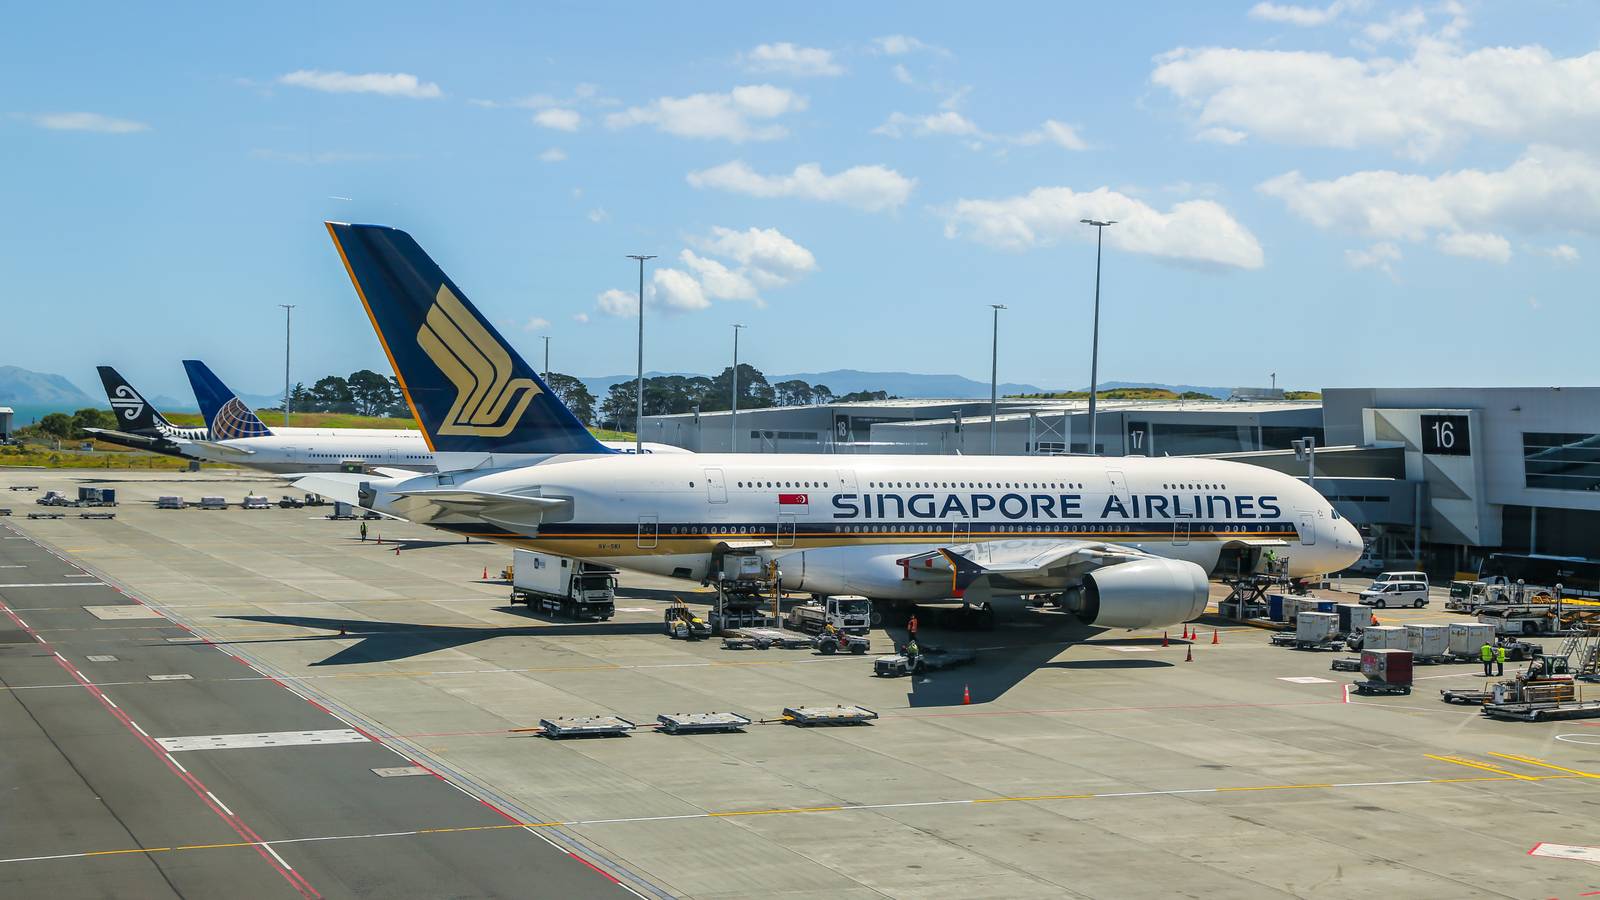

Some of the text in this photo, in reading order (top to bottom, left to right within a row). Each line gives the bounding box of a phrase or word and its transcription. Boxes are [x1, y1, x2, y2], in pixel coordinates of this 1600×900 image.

[837, 421, 847, 437] 18
[1130, 430, 1144, 449] 17
[1431, 421, 1455, 448] 16
[832, 493, 1281, 519] SINGAPORE AIRLINES
